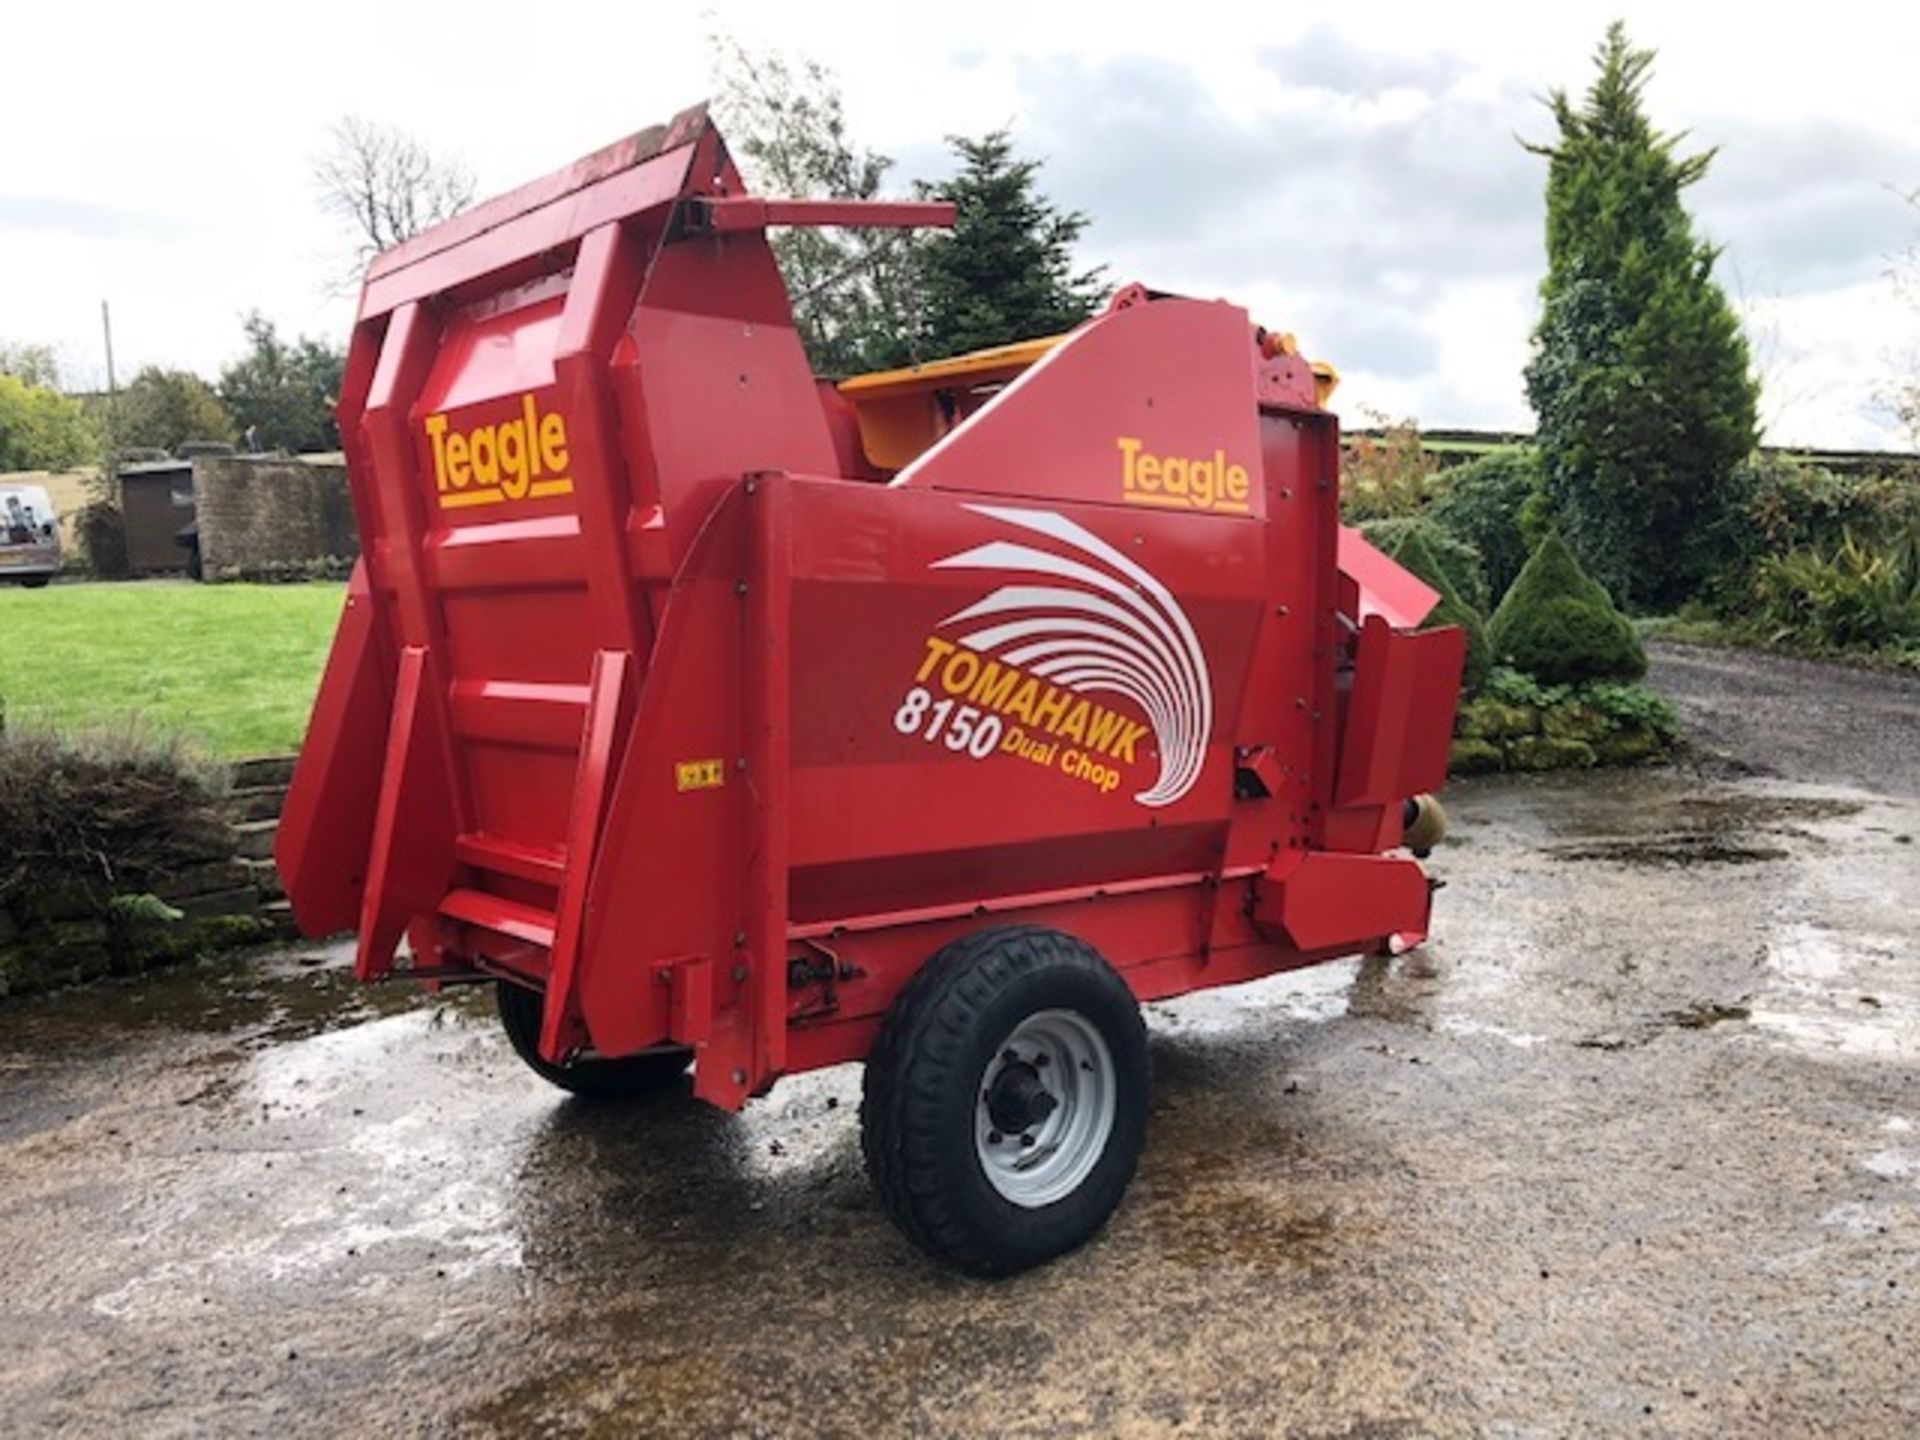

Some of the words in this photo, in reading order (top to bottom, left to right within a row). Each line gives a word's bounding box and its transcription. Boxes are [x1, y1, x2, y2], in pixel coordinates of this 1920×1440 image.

[425, 393, 572, 502] Teagle
[1117, 437, 1249, 508] Teagle
[894, 687, 1002, 759] 8150
[1001, 726, 1059, 766] Dual
[1060, 750, 1121, 793] Chop
[915, 637, 1149, 765] TOMAHAWK
